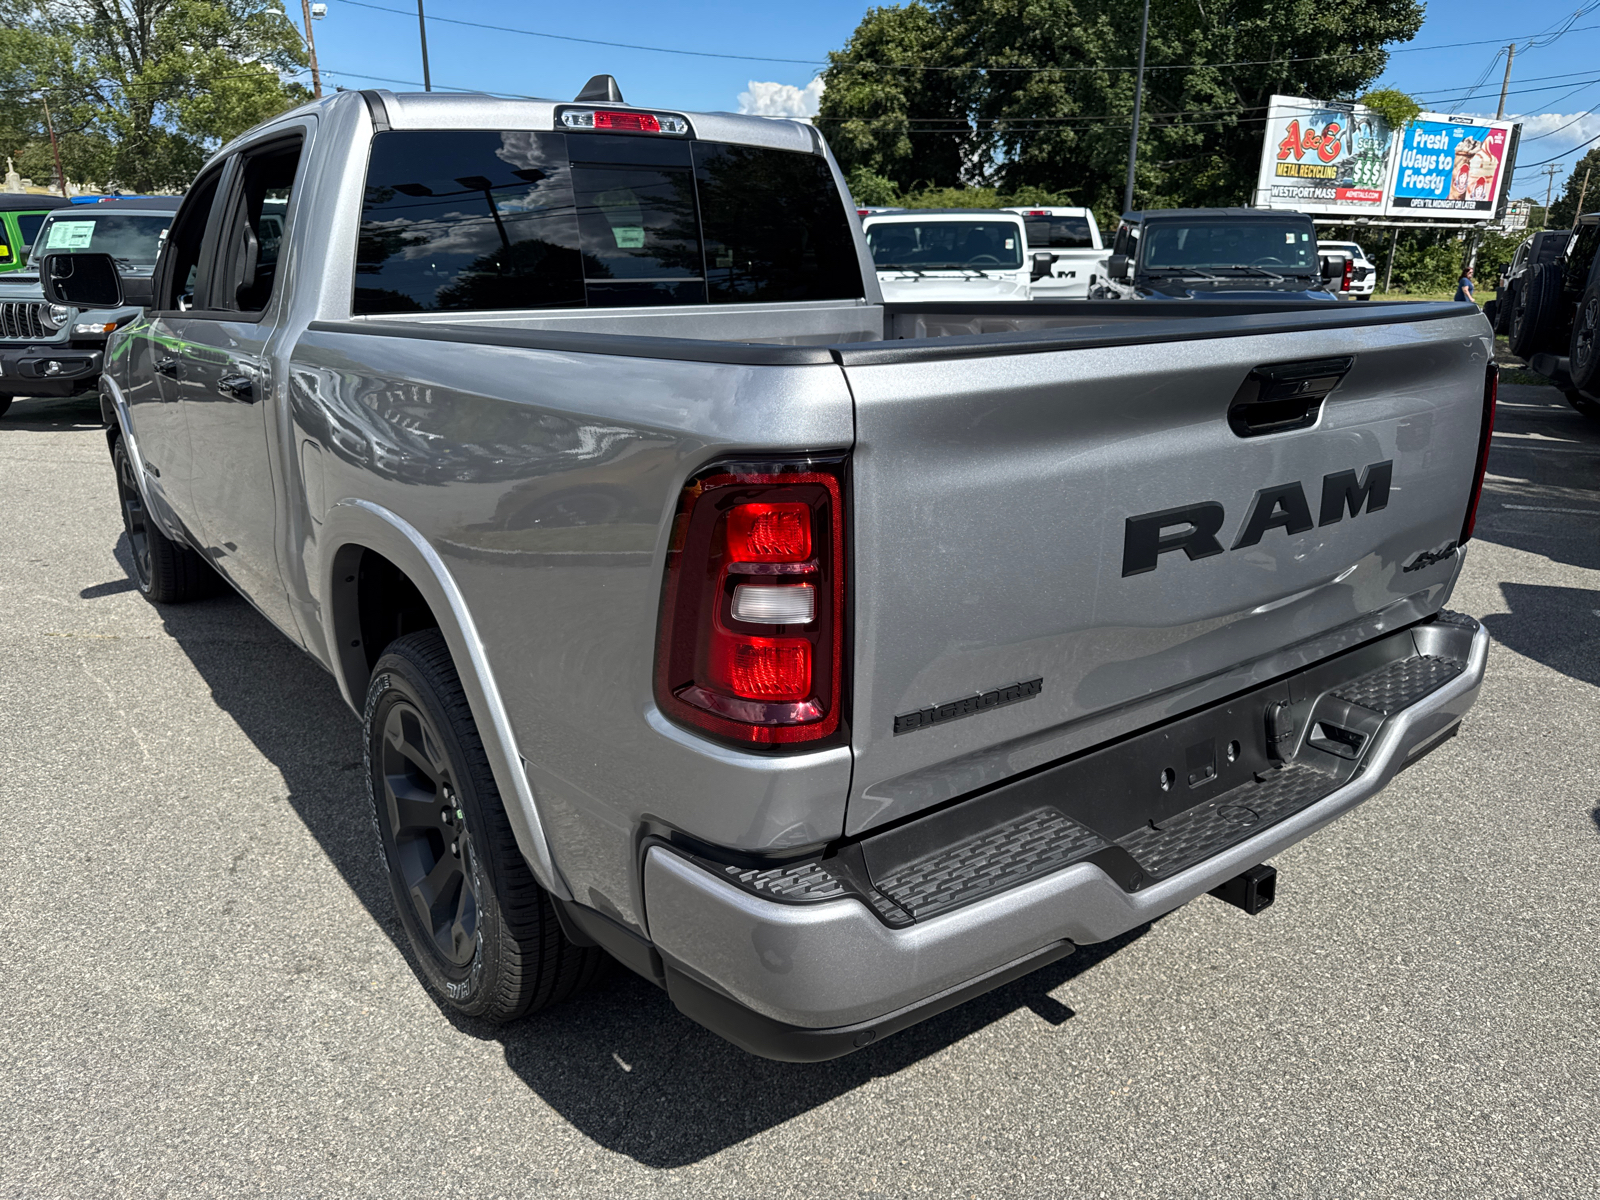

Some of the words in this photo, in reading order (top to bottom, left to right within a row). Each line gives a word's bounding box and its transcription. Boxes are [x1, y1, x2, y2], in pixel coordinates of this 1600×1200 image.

[1277, 119, 1341, 163] A&E
[1413, 129, 1448, 150] Fresh
[1276, 163, 1299, 177] METAL
[1300, 164, 1338, 179] RECYCLING
[1401, 149, 1437, 174] Ways
[1438, 153, 1453, 171] to
[1271, 186, 1314, 198] WESTPORT
[1314, 187, 1337, 199] MASS
[1403, 170, 1445, 194] Frosty
[1410, 199, 1424, 208] OPEN
[1432, 199, 1455, 209] MIDNIGHT
[1455, 200, 1462, 209] OR
[1462, 200, 1476, 210] LATER
[1121, 459, 1393, 578] RAM
